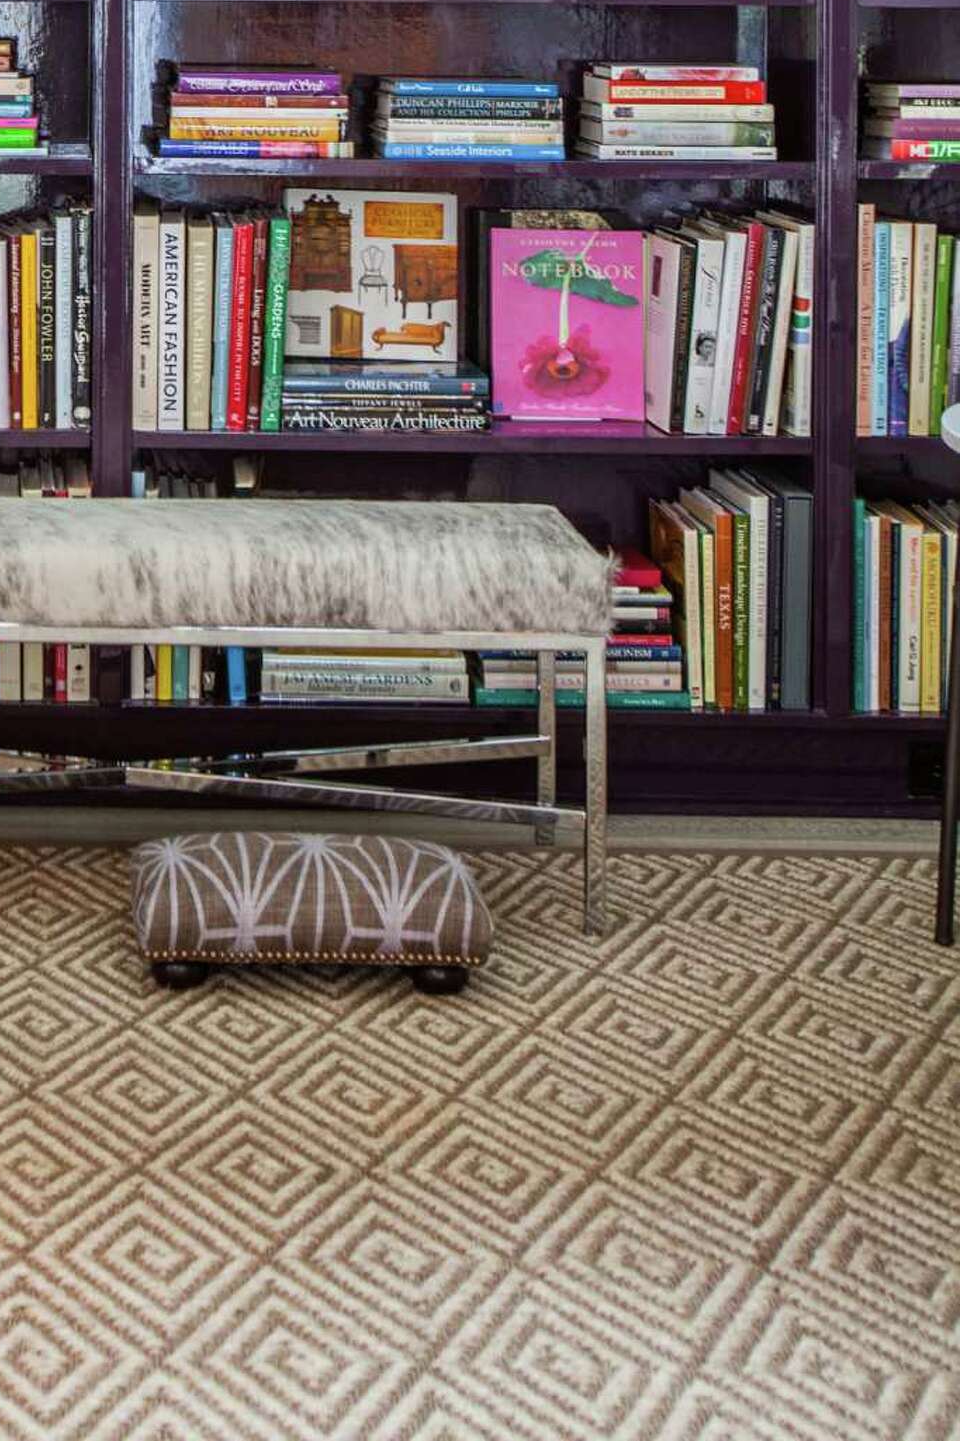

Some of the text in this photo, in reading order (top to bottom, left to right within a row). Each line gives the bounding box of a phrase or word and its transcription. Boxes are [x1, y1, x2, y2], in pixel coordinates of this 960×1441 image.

[204, 125, 320, 137] ART NOUVEAU
[502, 261, 637, 280] NOTEBOOK
[41, 263, 53, 362] JOHN FOWLER
[75, 295, 91, 330] Hector
[140, 263, 152, 347] MODERN ART
[164, 232, 180, 412] AMERICAN FASHION
[251, 289, 264, 318] Living
[271, 284, 284, 340] GARDENS
[74, 331, 90, 383] Guimard
[250, 335, 262, 367] DOGS
[288, 411, 486, 430] Art Nouveau Architecture
[734, 522, 748, 646] Timeless Landscape Design
[719, 583, 730, 630] TEXAS
[362, 674, 434, 686] GARDENS
